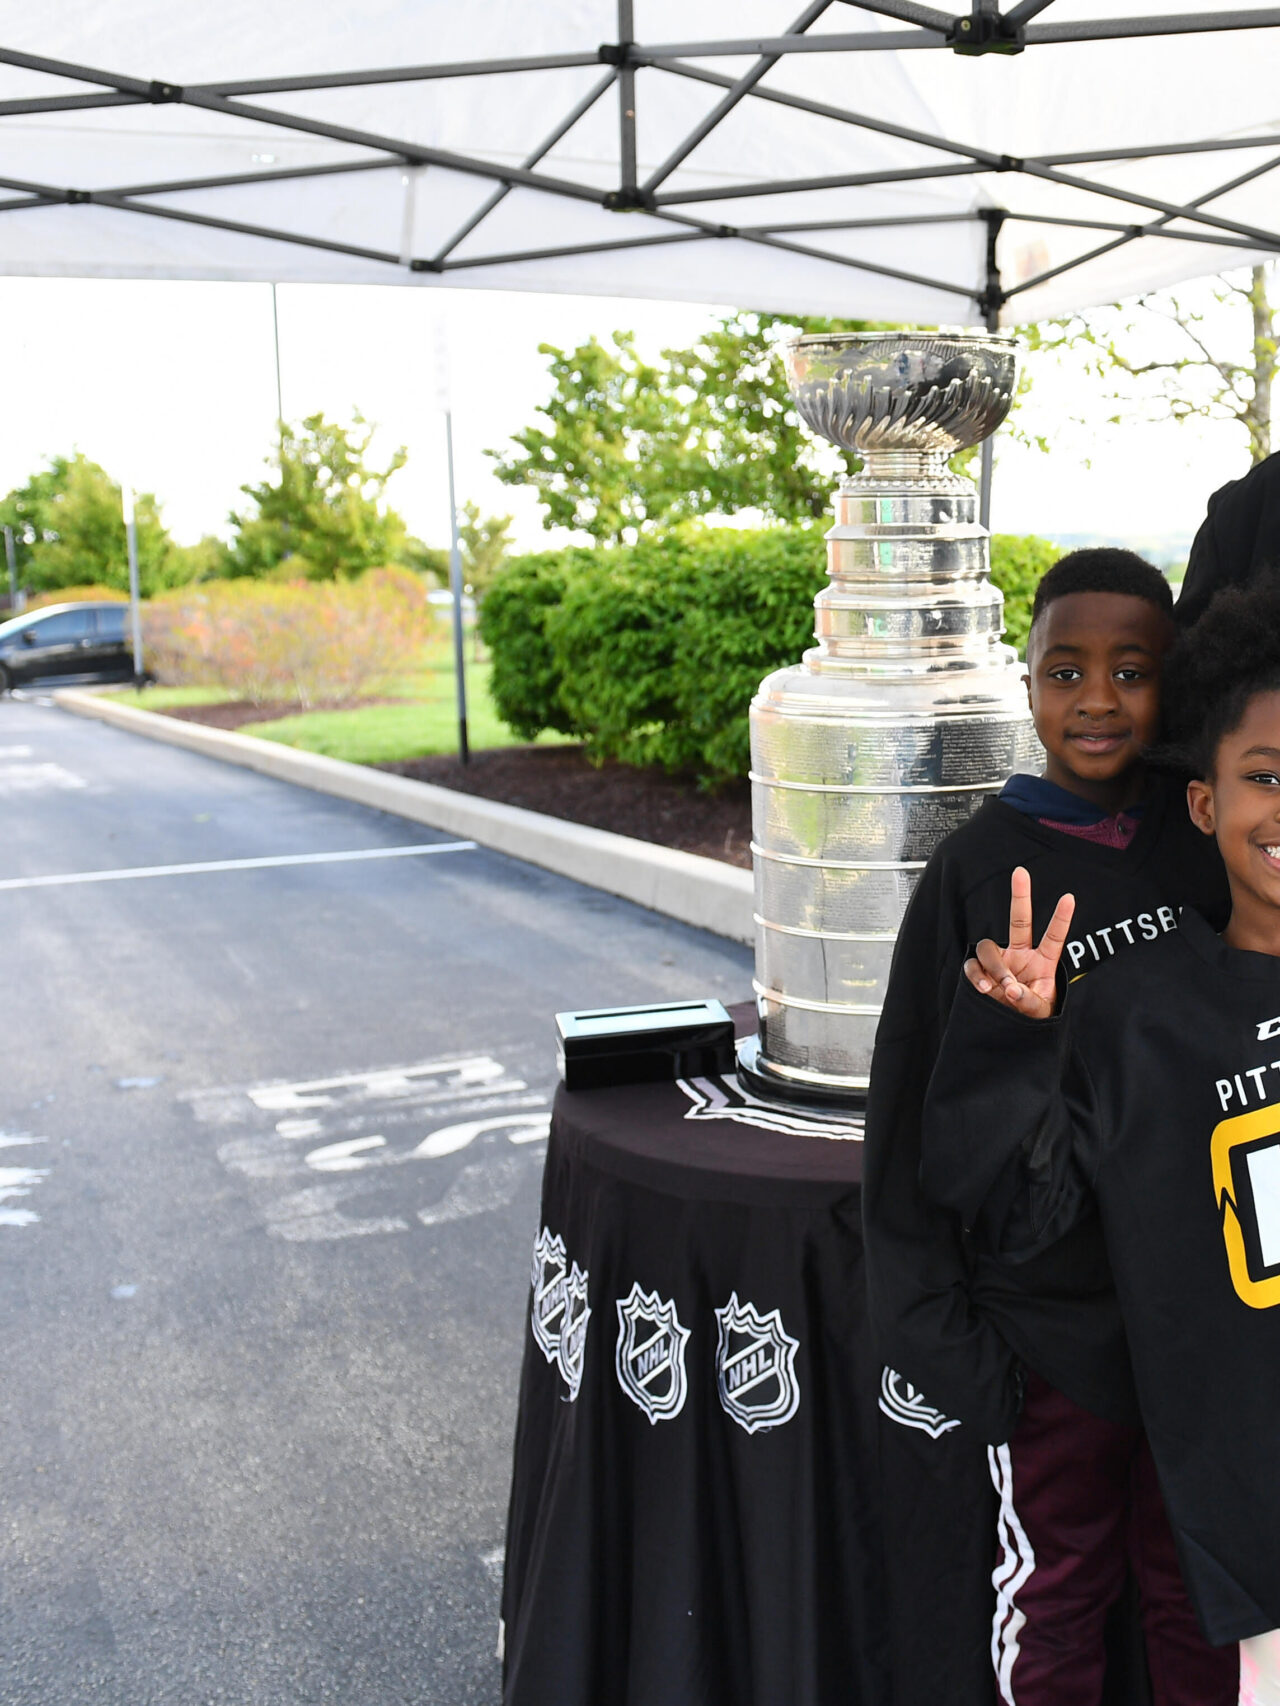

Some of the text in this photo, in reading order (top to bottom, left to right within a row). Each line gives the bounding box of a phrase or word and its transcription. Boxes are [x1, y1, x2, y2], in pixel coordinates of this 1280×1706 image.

[1066, 905, 1184, 970] PITTSB
[637, 1337, 669, 1380] NHL
[728, 1350, 772, 1391] NHL
